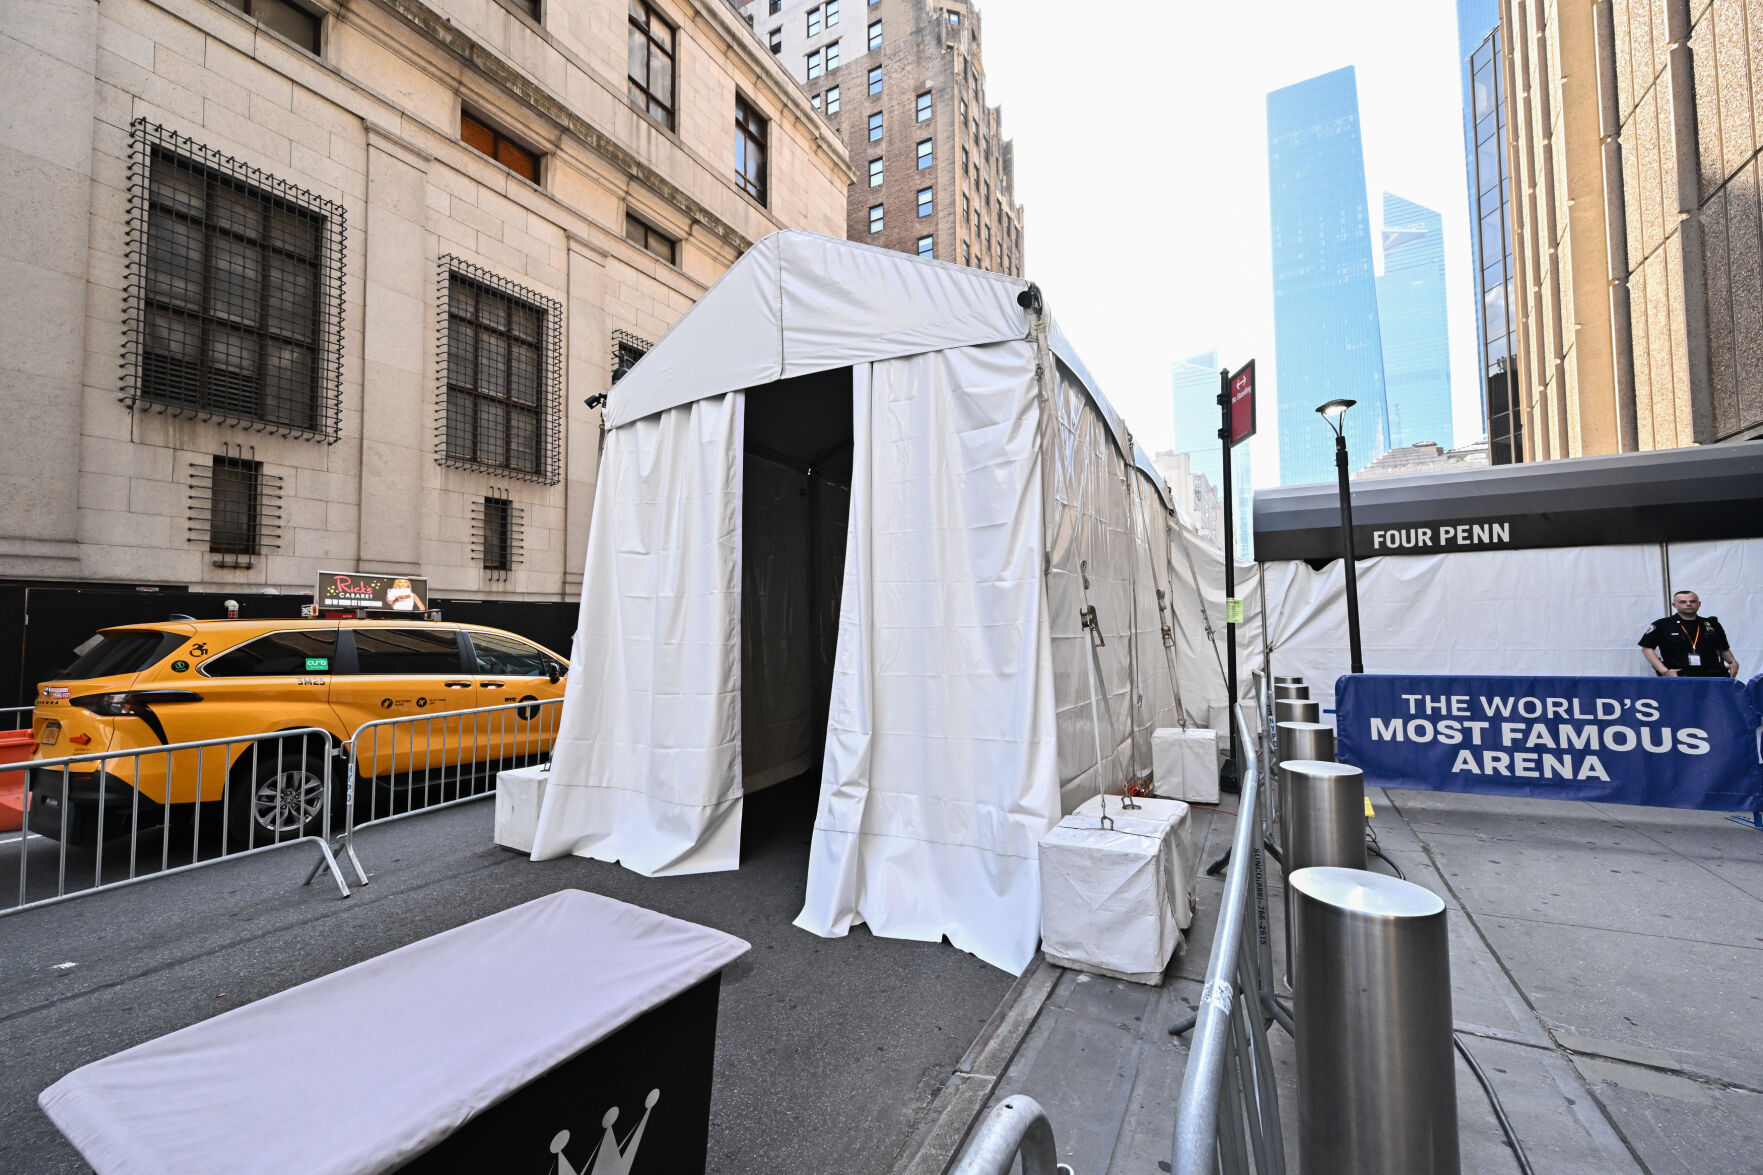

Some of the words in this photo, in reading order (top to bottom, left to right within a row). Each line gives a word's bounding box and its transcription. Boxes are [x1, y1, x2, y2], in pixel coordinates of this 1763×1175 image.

[1236, 386, 1251, 400] Standing
[1373, 527, 1433, 549] FOUR
[1439, 522, 1510, 546] PENN
[334, 575, 373, 593] Rick's
[1402, 694, 1472, 717] THE
[1480, 696, 1660, 722] WORLD'S
[1269, 717, 1278, 748] NYPD
[1370, 717, 1489, 746] MOST
[1501, 722, 1711, 755] FAMOUS
[1451, 749, 1611, 782] ARENA
